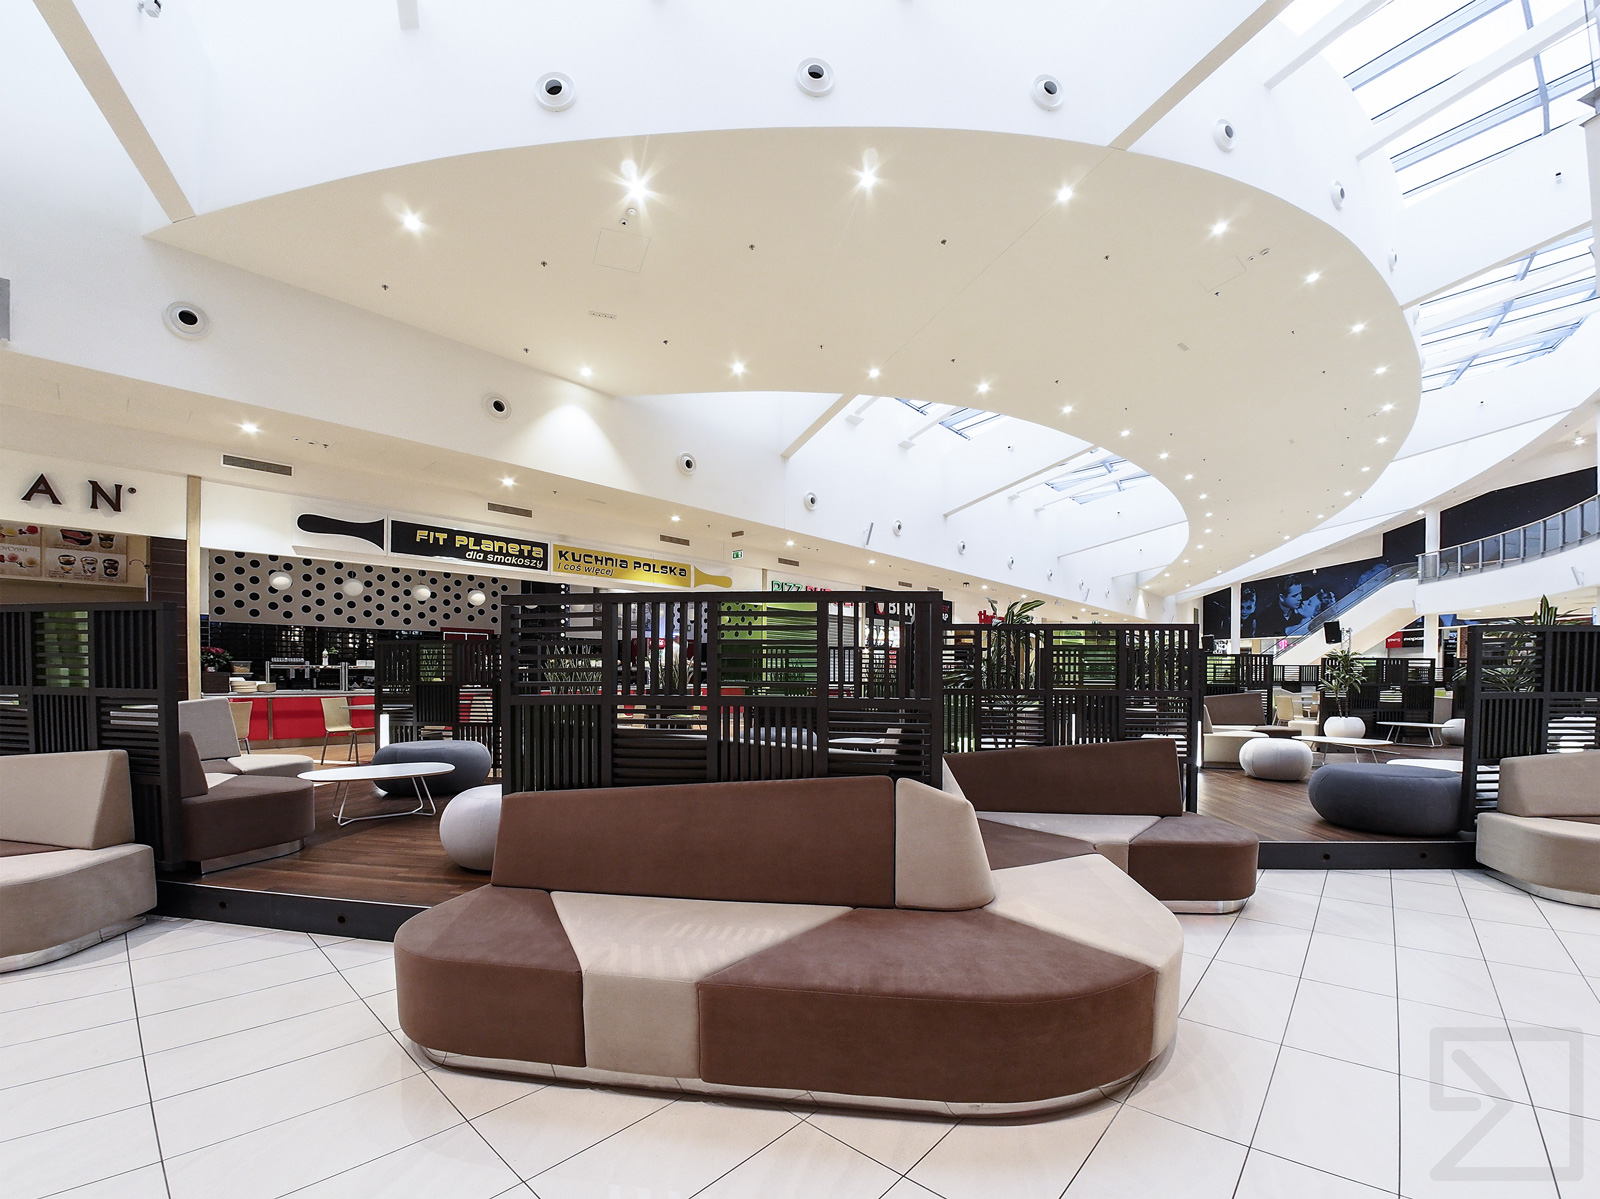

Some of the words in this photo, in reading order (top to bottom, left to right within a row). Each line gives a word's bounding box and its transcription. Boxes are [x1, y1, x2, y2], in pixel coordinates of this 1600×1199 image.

[416, 530, 448, 545] FIT
[465, 550, 484, 560] dla
[486, 552, 543, 568] smakoszy
[563, 563, 582, 572] coś
[584, 566, 614, 577] więcej
